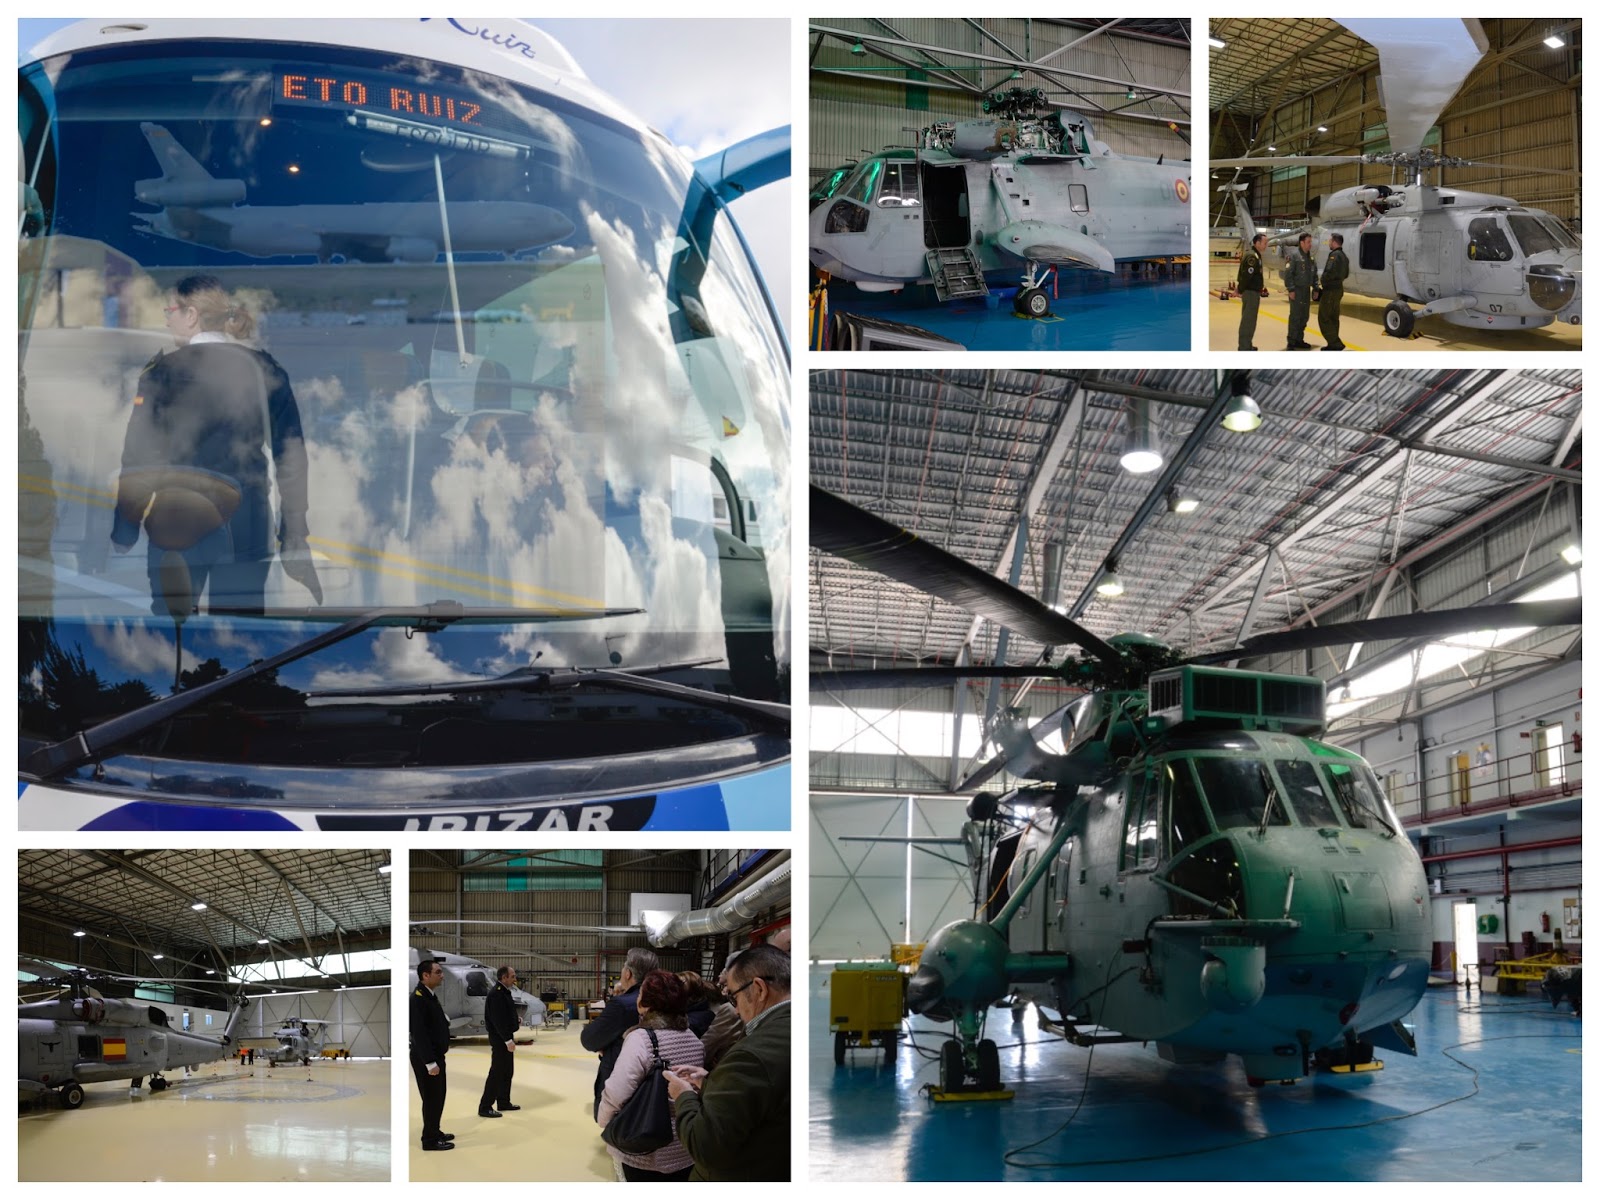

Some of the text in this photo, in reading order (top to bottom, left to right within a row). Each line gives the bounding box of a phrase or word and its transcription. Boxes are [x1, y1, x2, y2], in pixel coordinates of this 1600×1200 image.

[283, 75, 481, 126] ETO RUIZ
[1489, 304, 1503, 313] 07
